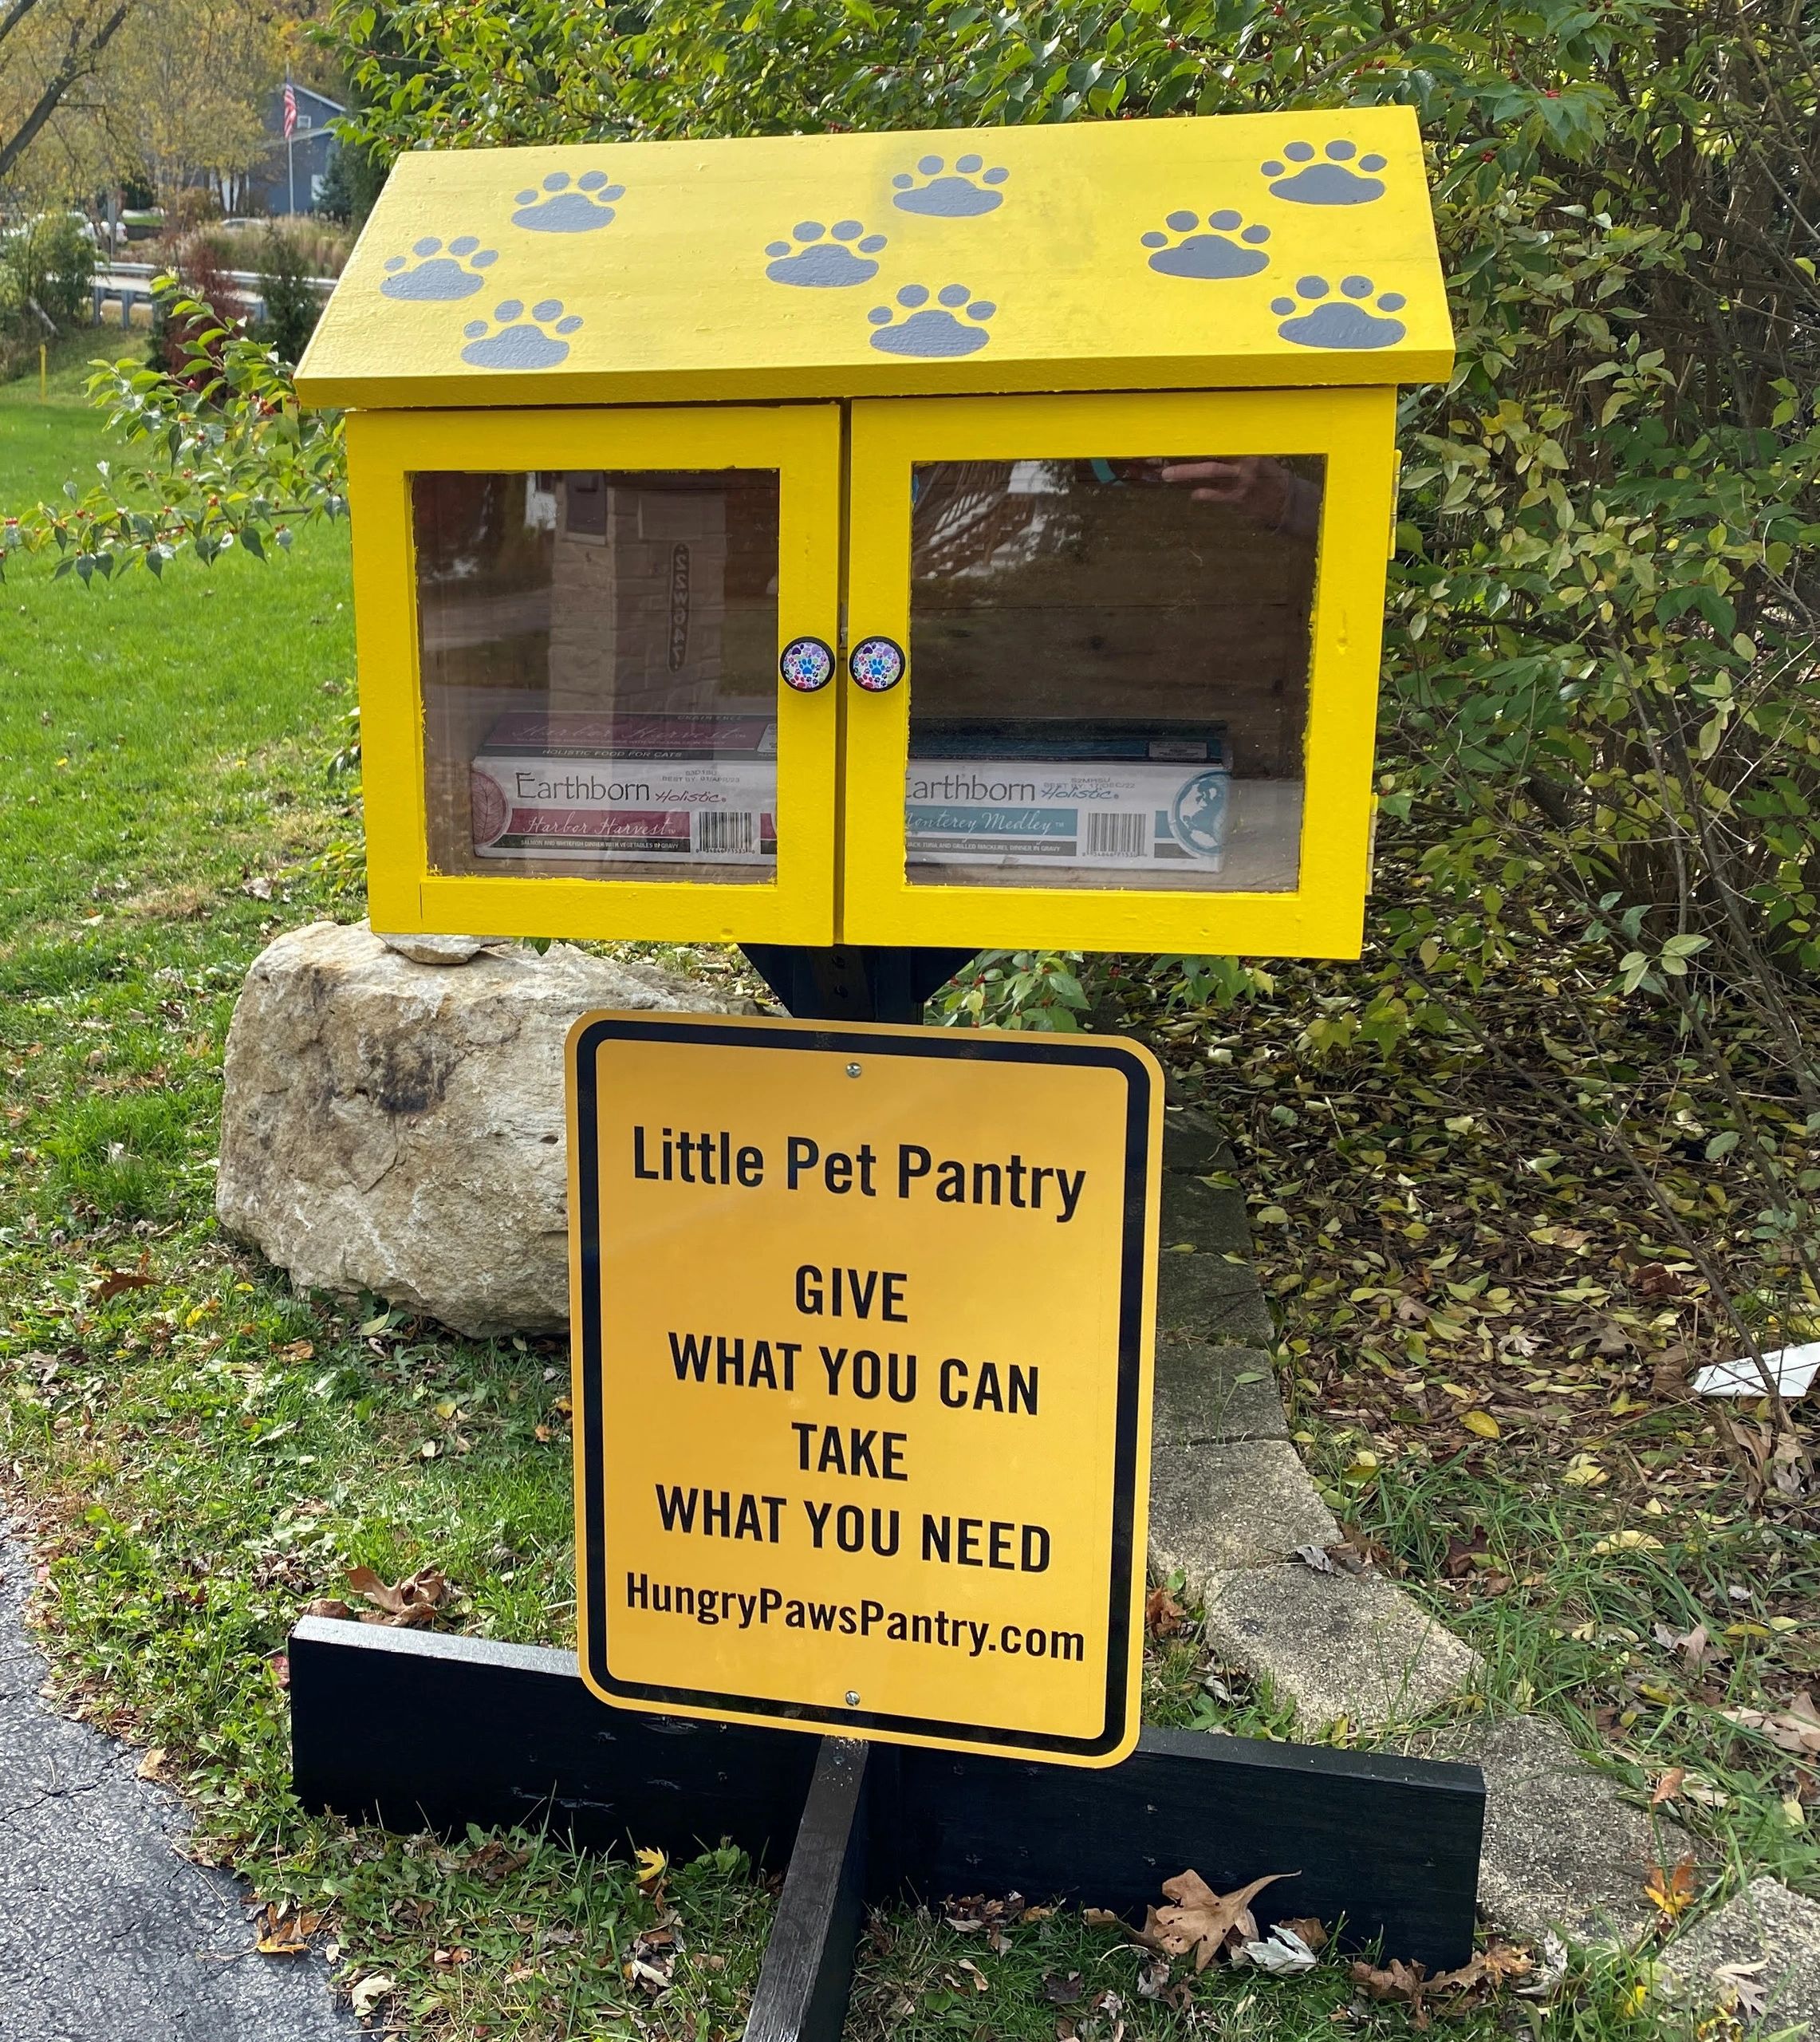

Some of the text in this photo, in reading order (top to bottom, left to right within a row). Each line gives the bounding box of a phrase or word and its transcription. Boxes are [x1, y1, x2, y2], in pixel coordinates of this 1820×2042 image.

[515, 771, 651, 802] Earthborn
[522, 810, 589, 834] Harbor
[594, 816, 672, 836] Harvest
[981, 810, 1051, 846] Medley
[634, 1126, 1086, 1223] Little Pet Pantry
[795, 1264, 908, 1323] GIVE
[668, 1332, 1038, 1416] WHAT YOU CAN
[792, 1422, 908, 1481] TAKE
[656, 1484, 1050, 1573] WHAT YOU NEED
[627, 1571, 1084, 1662] HungryPawsPantry.com
